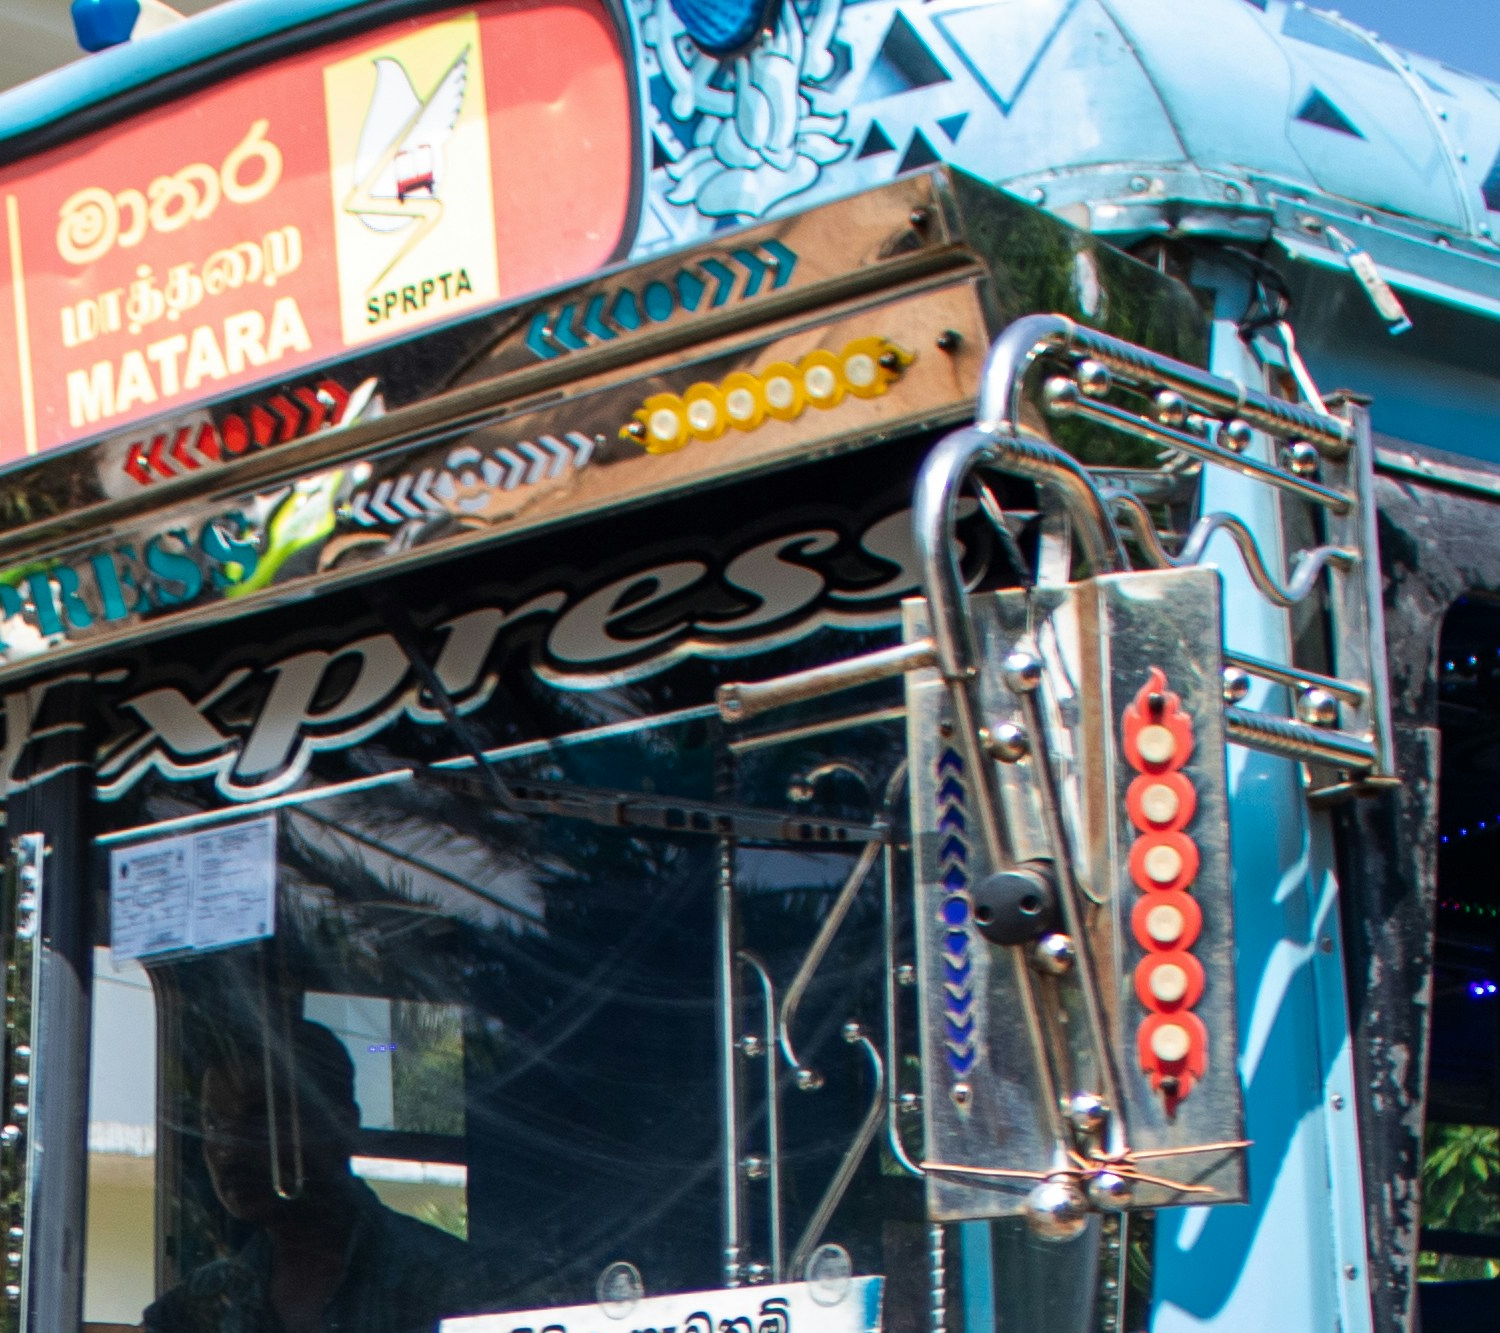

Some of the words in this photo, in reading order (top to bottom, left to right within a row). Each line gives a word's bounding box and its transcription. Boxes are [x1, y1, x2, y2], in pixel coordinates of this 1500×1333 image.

[56, 118, 284, 265] මාතර
[65, 295, 313, 428] MATARA
[365, 267, 474, 326] SPRPTA
